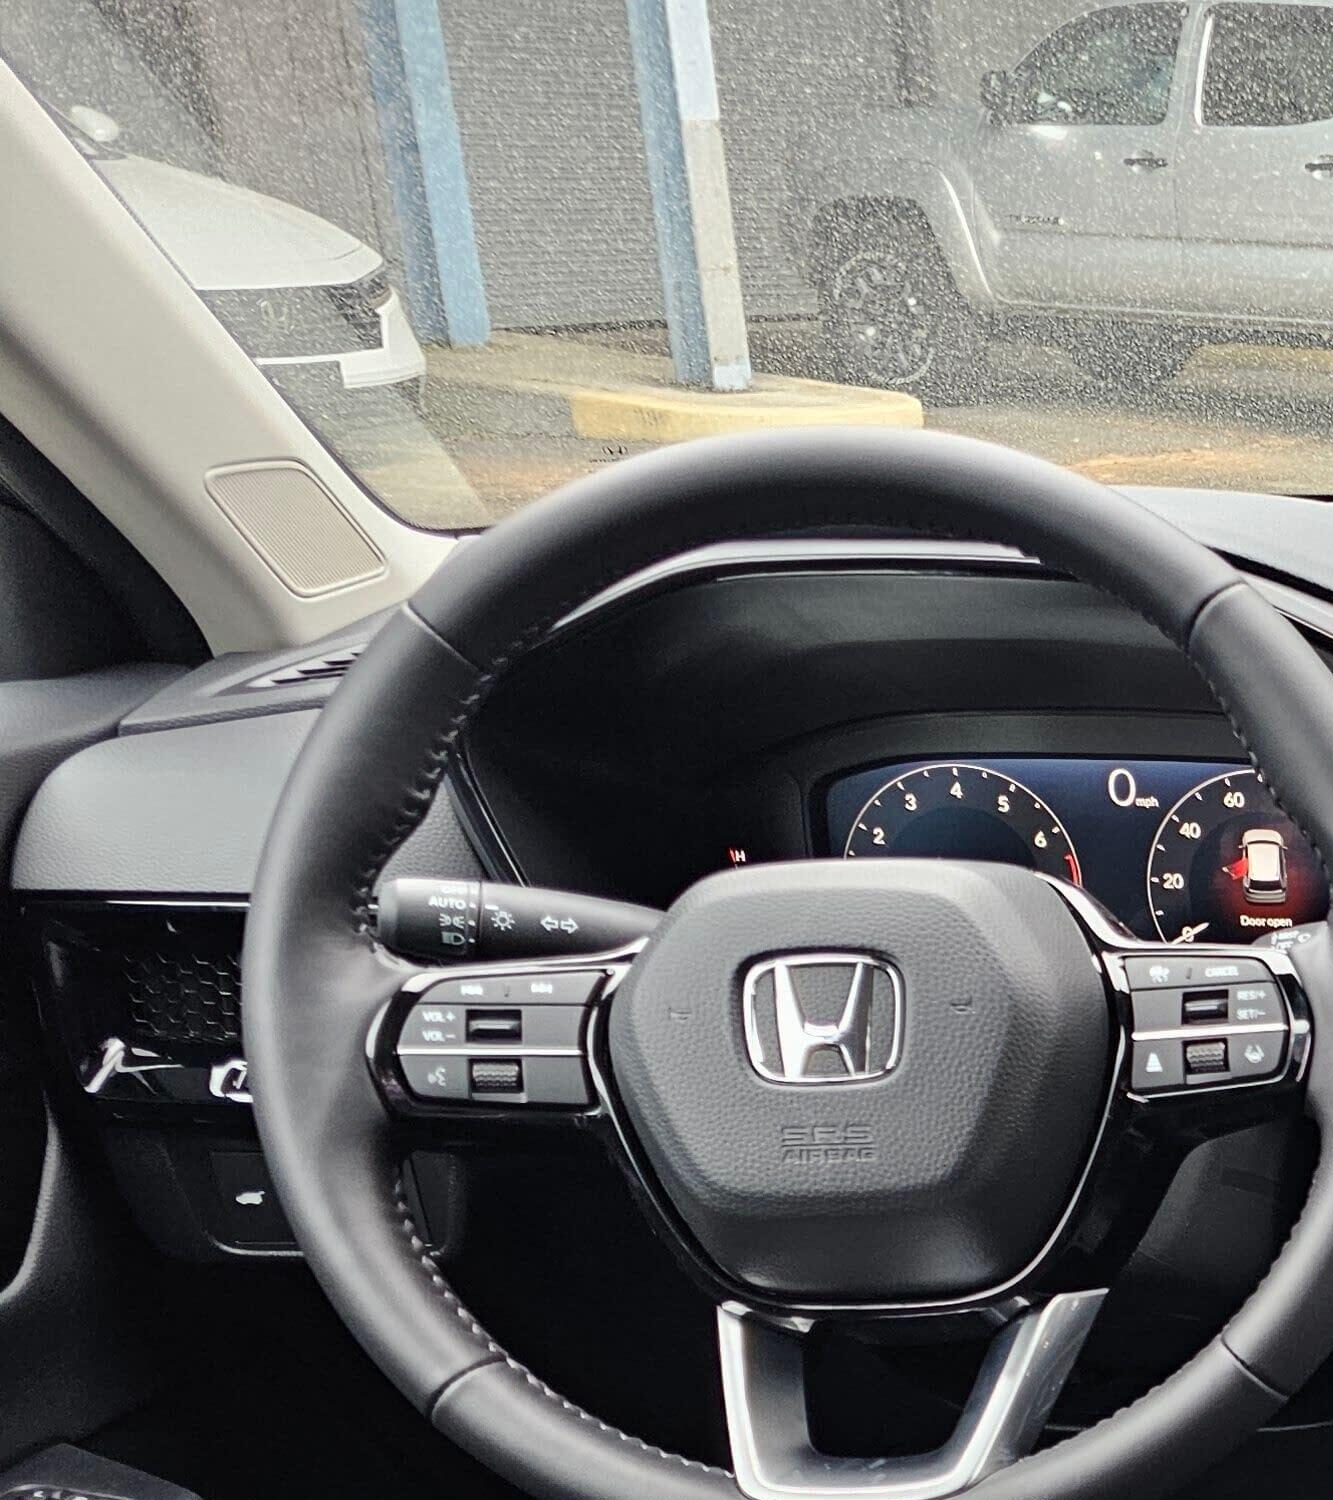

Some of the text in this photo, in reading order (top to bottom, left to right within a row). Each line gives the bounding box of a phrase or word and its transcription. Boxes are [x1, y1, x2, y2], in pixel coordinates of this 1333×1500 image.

[950, 781, 963, 798] 4
[1108, 768, 1159, 809] 0 mph
[904, 793, 917, 811] 3
[997, 795, 1010, 813] 5
[1223, 792, 1245, 808] 60
[872, 827, 886, 845] 2
[1034, 830, 1047, 848] 6
[1179, 822, 1201, 839] 40
[735, 850, 746, 862] H
[1162, 873, 1184, 889] 20
[429, 895, 467, 910] AUTO
[1240, 915, 1293, 928] Door open
